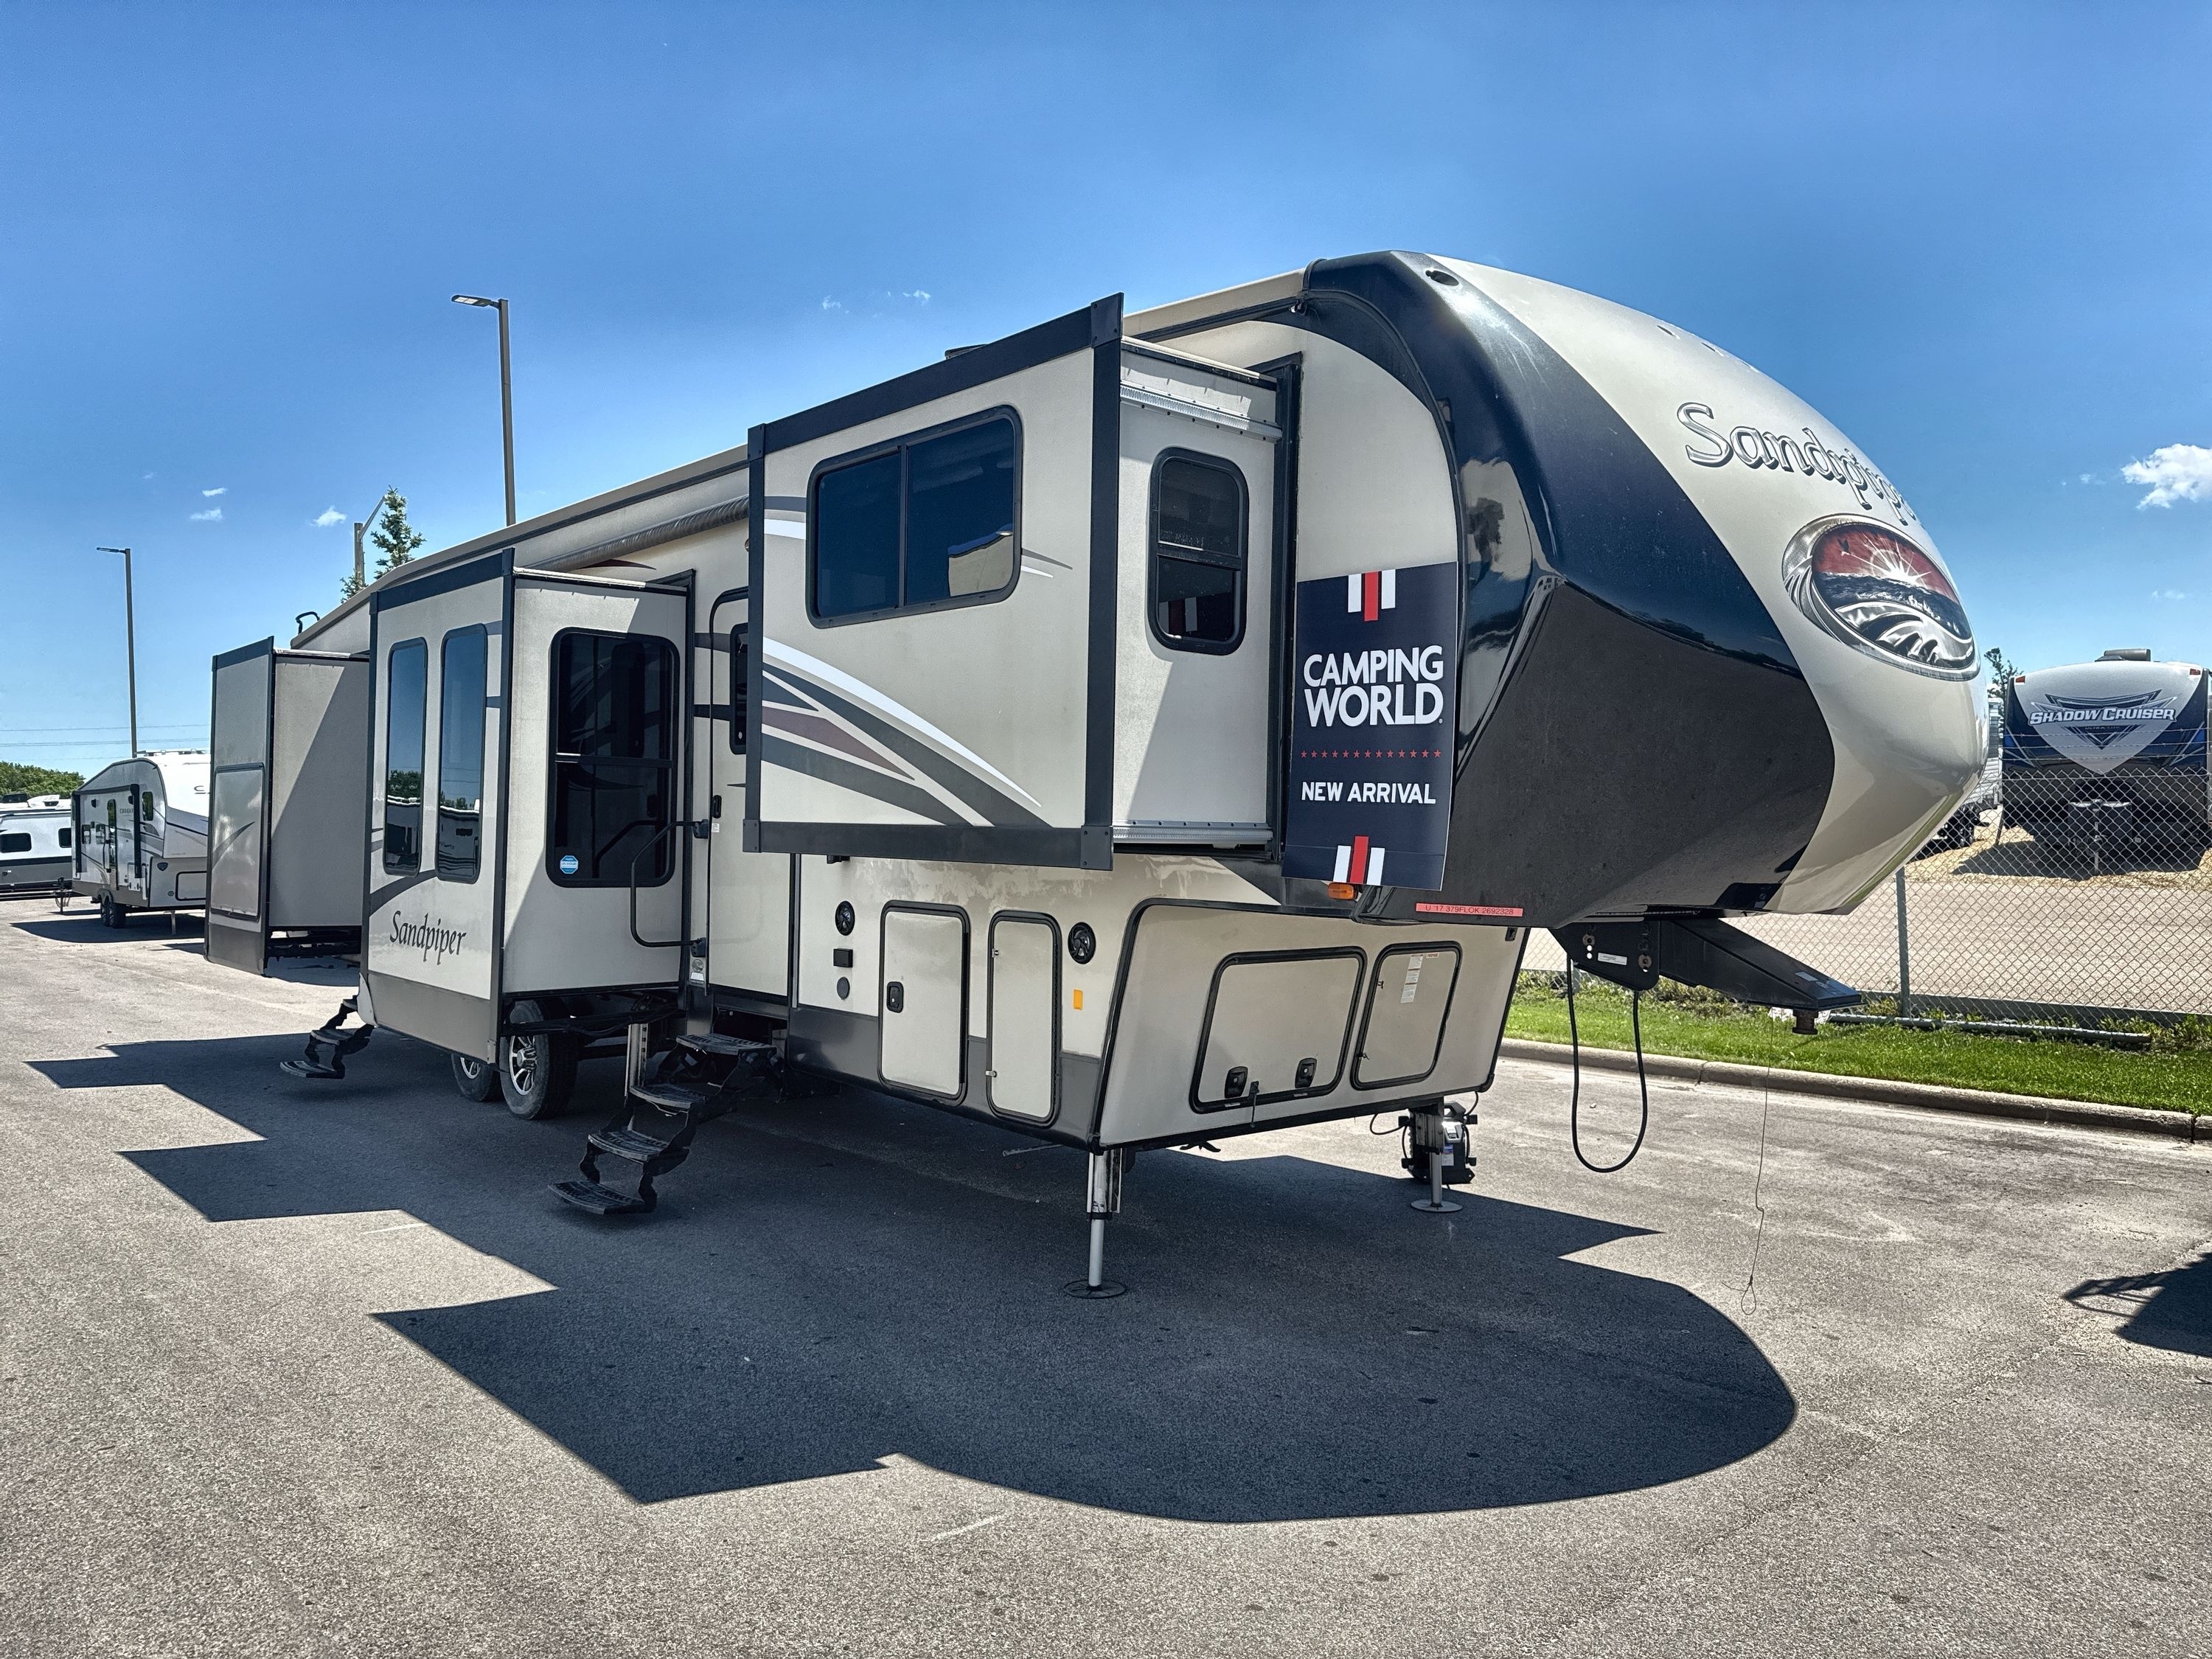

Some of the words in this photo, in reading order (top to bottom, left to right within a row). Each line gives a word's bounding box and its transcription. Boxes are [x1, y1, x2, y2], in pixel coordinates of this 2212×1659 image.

[1304, 645, 1444, 687] CAMPING
[1304, 683, 1444, 728] WORLD
[2030, 710, 2101, 725] SHADOW
[1301, 782, 1343, 801] NEW
[1347, 782, 1436, 804] ARRIVAL
[389, 910, 467, 965] Sandpiper
